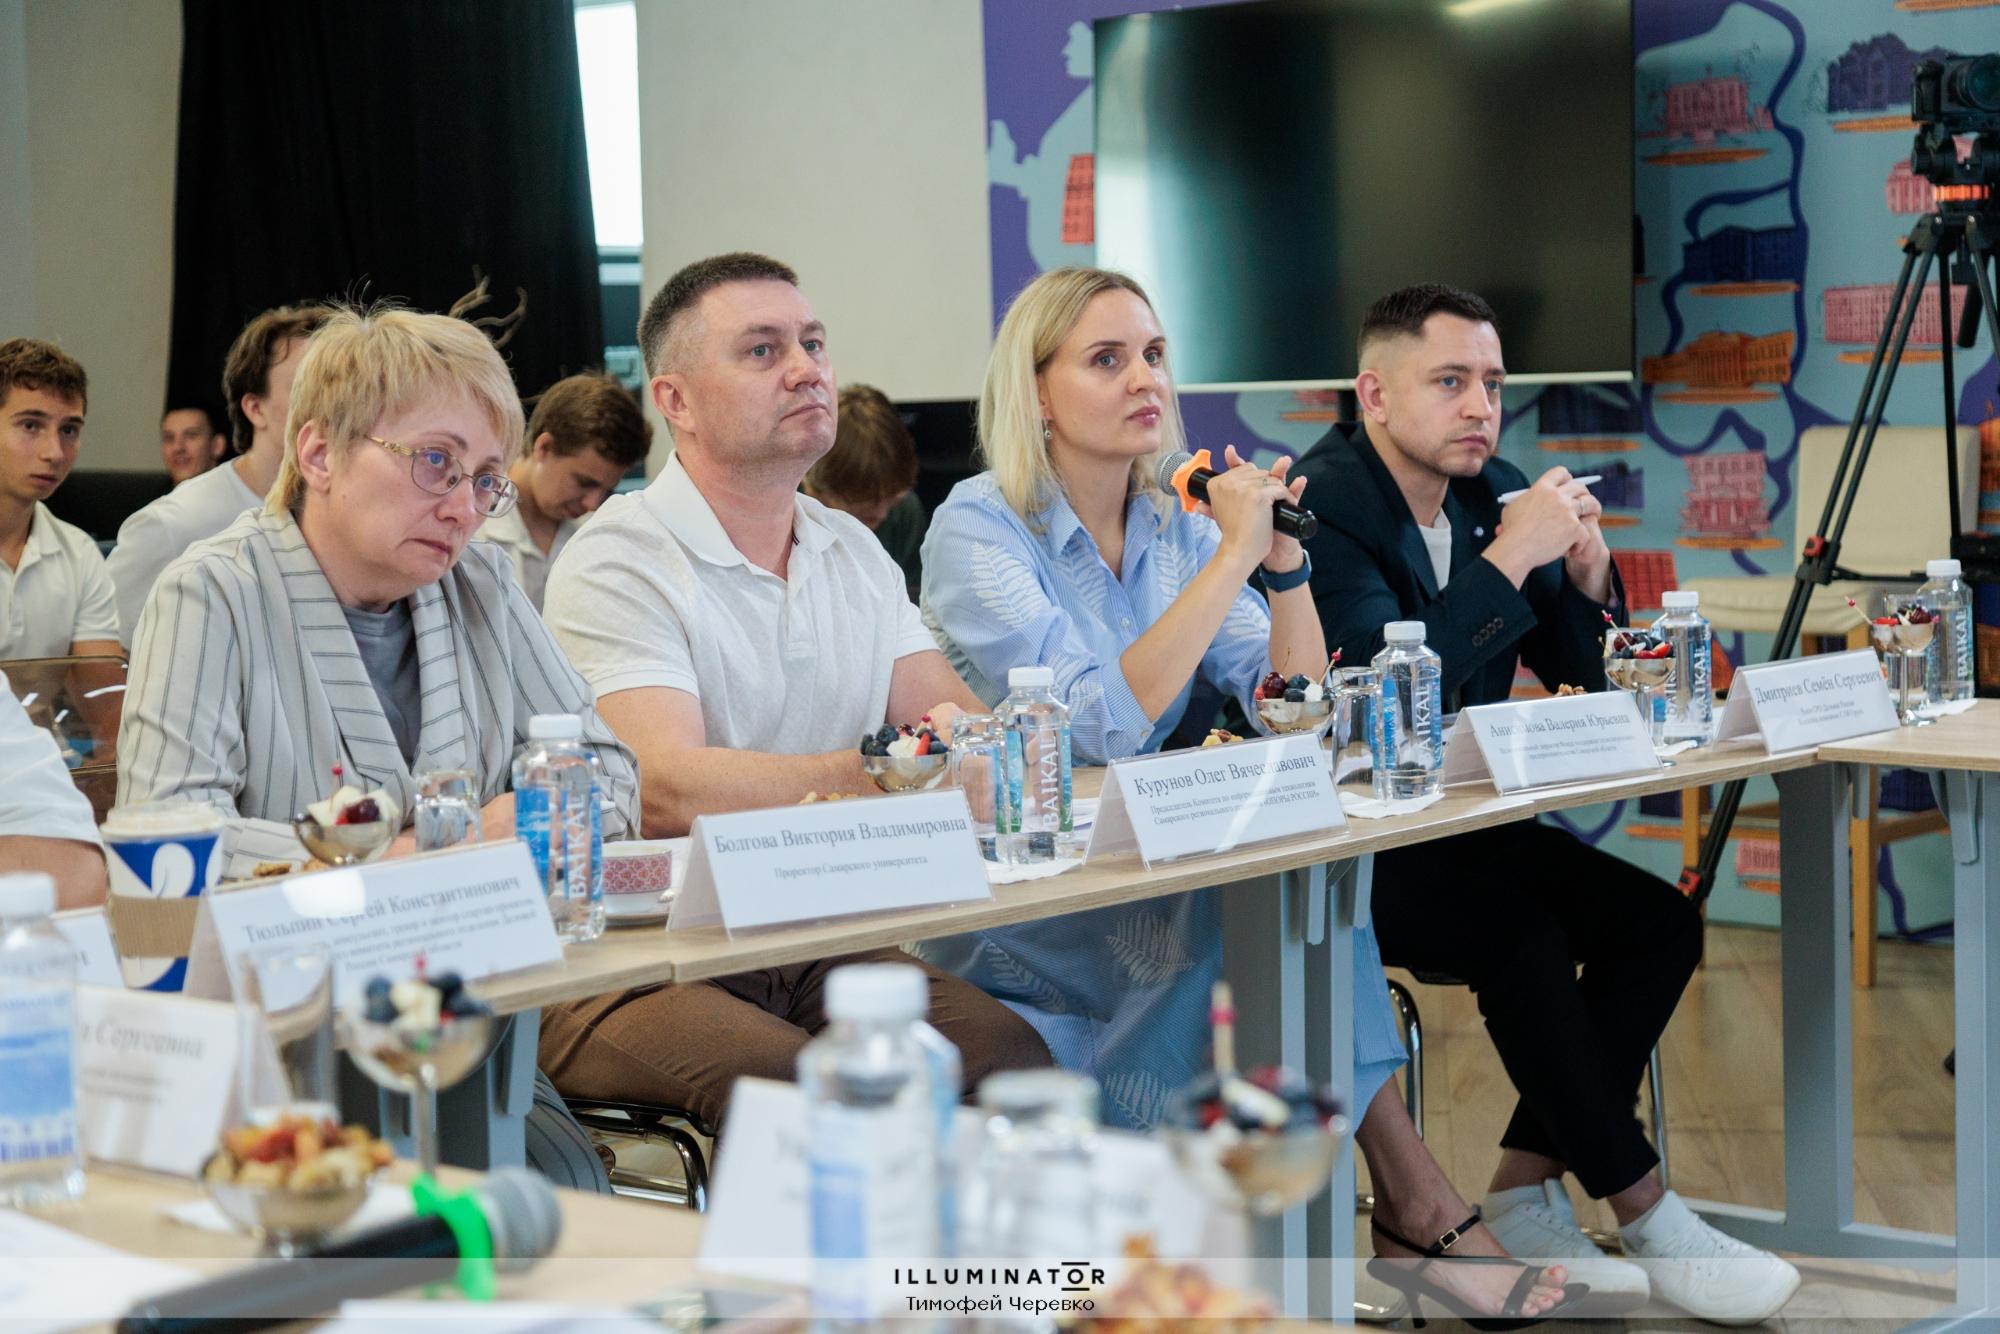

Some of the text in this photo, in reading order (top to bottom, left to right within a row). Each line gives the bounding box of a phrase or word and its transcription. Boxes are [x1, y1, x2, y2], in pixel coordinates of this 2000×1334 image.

[1755, 686, 1803, 704] Дмитриев
[1803, 676, 1834, 694] Семён
[1545, 717, 1587, 732] Валерия
[1040, 736, 1059, 827] BAIKAL
[1133, 775, 1194, 798] Курунов
[1195, 768, 1226, 785] Олег
[566, 793, 587, 899] BAIKAL
[714, 817, 968, 854] Болгова Виктория Владимировна
[774, 855, 928, 880] Проректор Самарского университета
[388, 876, 521, 916] Константинович
